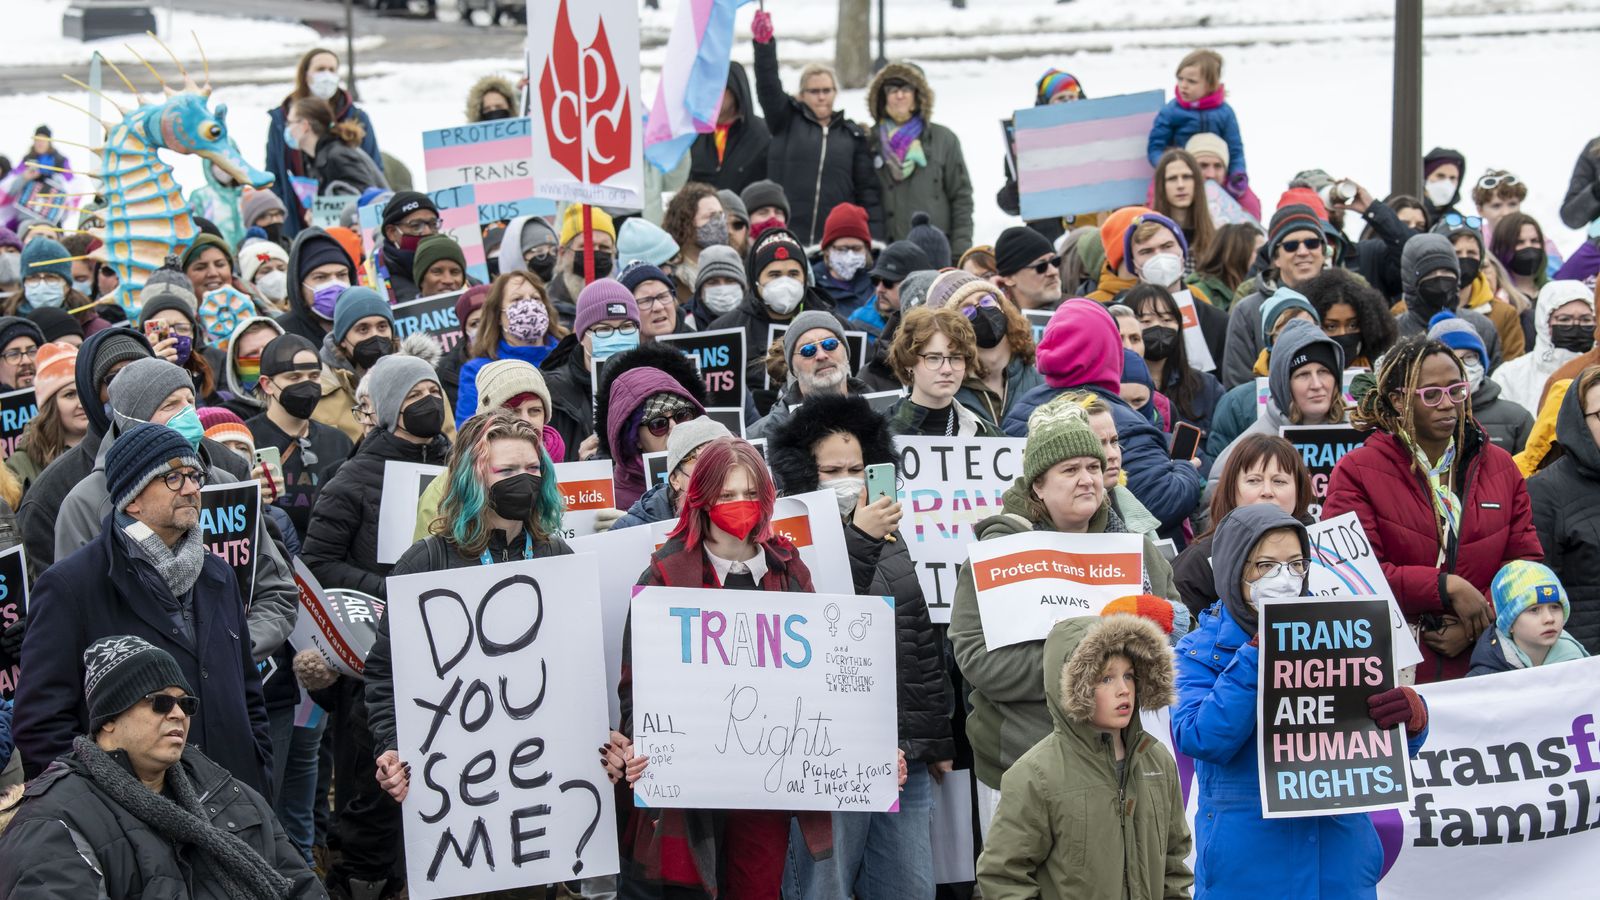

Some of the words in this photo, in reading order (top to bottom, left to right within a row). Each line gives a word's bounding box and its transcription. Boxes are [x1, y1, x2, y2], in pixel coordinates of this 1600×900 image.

[440, 119, 531, 146] PROTECT
[458, 161, 529, 182] TRANS
[403, 202, 419, 212] FCC
[478, 201, 520, 229] KIDS
[901, 446, 1026, 482] OTEC
[579, 490, 606, 504] kids.
[200, 504, 246, 535] ANS
[1308, 520, 1370, 568] KIDS
[990, 560, 1049, 582] Protect
[1052, 560, 1085, 577] trans
[1089, 564, 1126, 578] kids.
[341, 594, 375, 624] ARE
[1040, 595, 1090, 609] ALWAYS
[418, 574, 543, 680] DO
[669, 607, 812, 669] TRANS
[1272, 619, 1373, 651] TRANS
[825, 652, 872, 667] EVERYTHING
[1273, 656, 1384, 689] RIGHTS
[825, 673, 874, 686] EVERYTHING
[828, 682, 837, 692] IN
[840, 684, 870, 693] BETWEEN
[412, 657, 546, 756] YOU
[1273, 695, 1335, 726] ARE
[643, 712, 687, 735] ALL
[636, 735, 675, 753] Trans
[715, 683, 841, 793] Rights
[1273, 730, 1393, 763] HUMAN
[1410, 713, 1600, 788] ransf
[640, 753, 673, 767] ople
[802, 760, 848, 780] Protect
[643, 783, 681, 798] VALID
[786, 779, 806, 794] and
[814, 779, 872, 795] Intersex
[1277, 766, 1403, 800] RIGHTS.
[834, 795, 871, 809] youth
[426, 778, 601, 881] ME?
